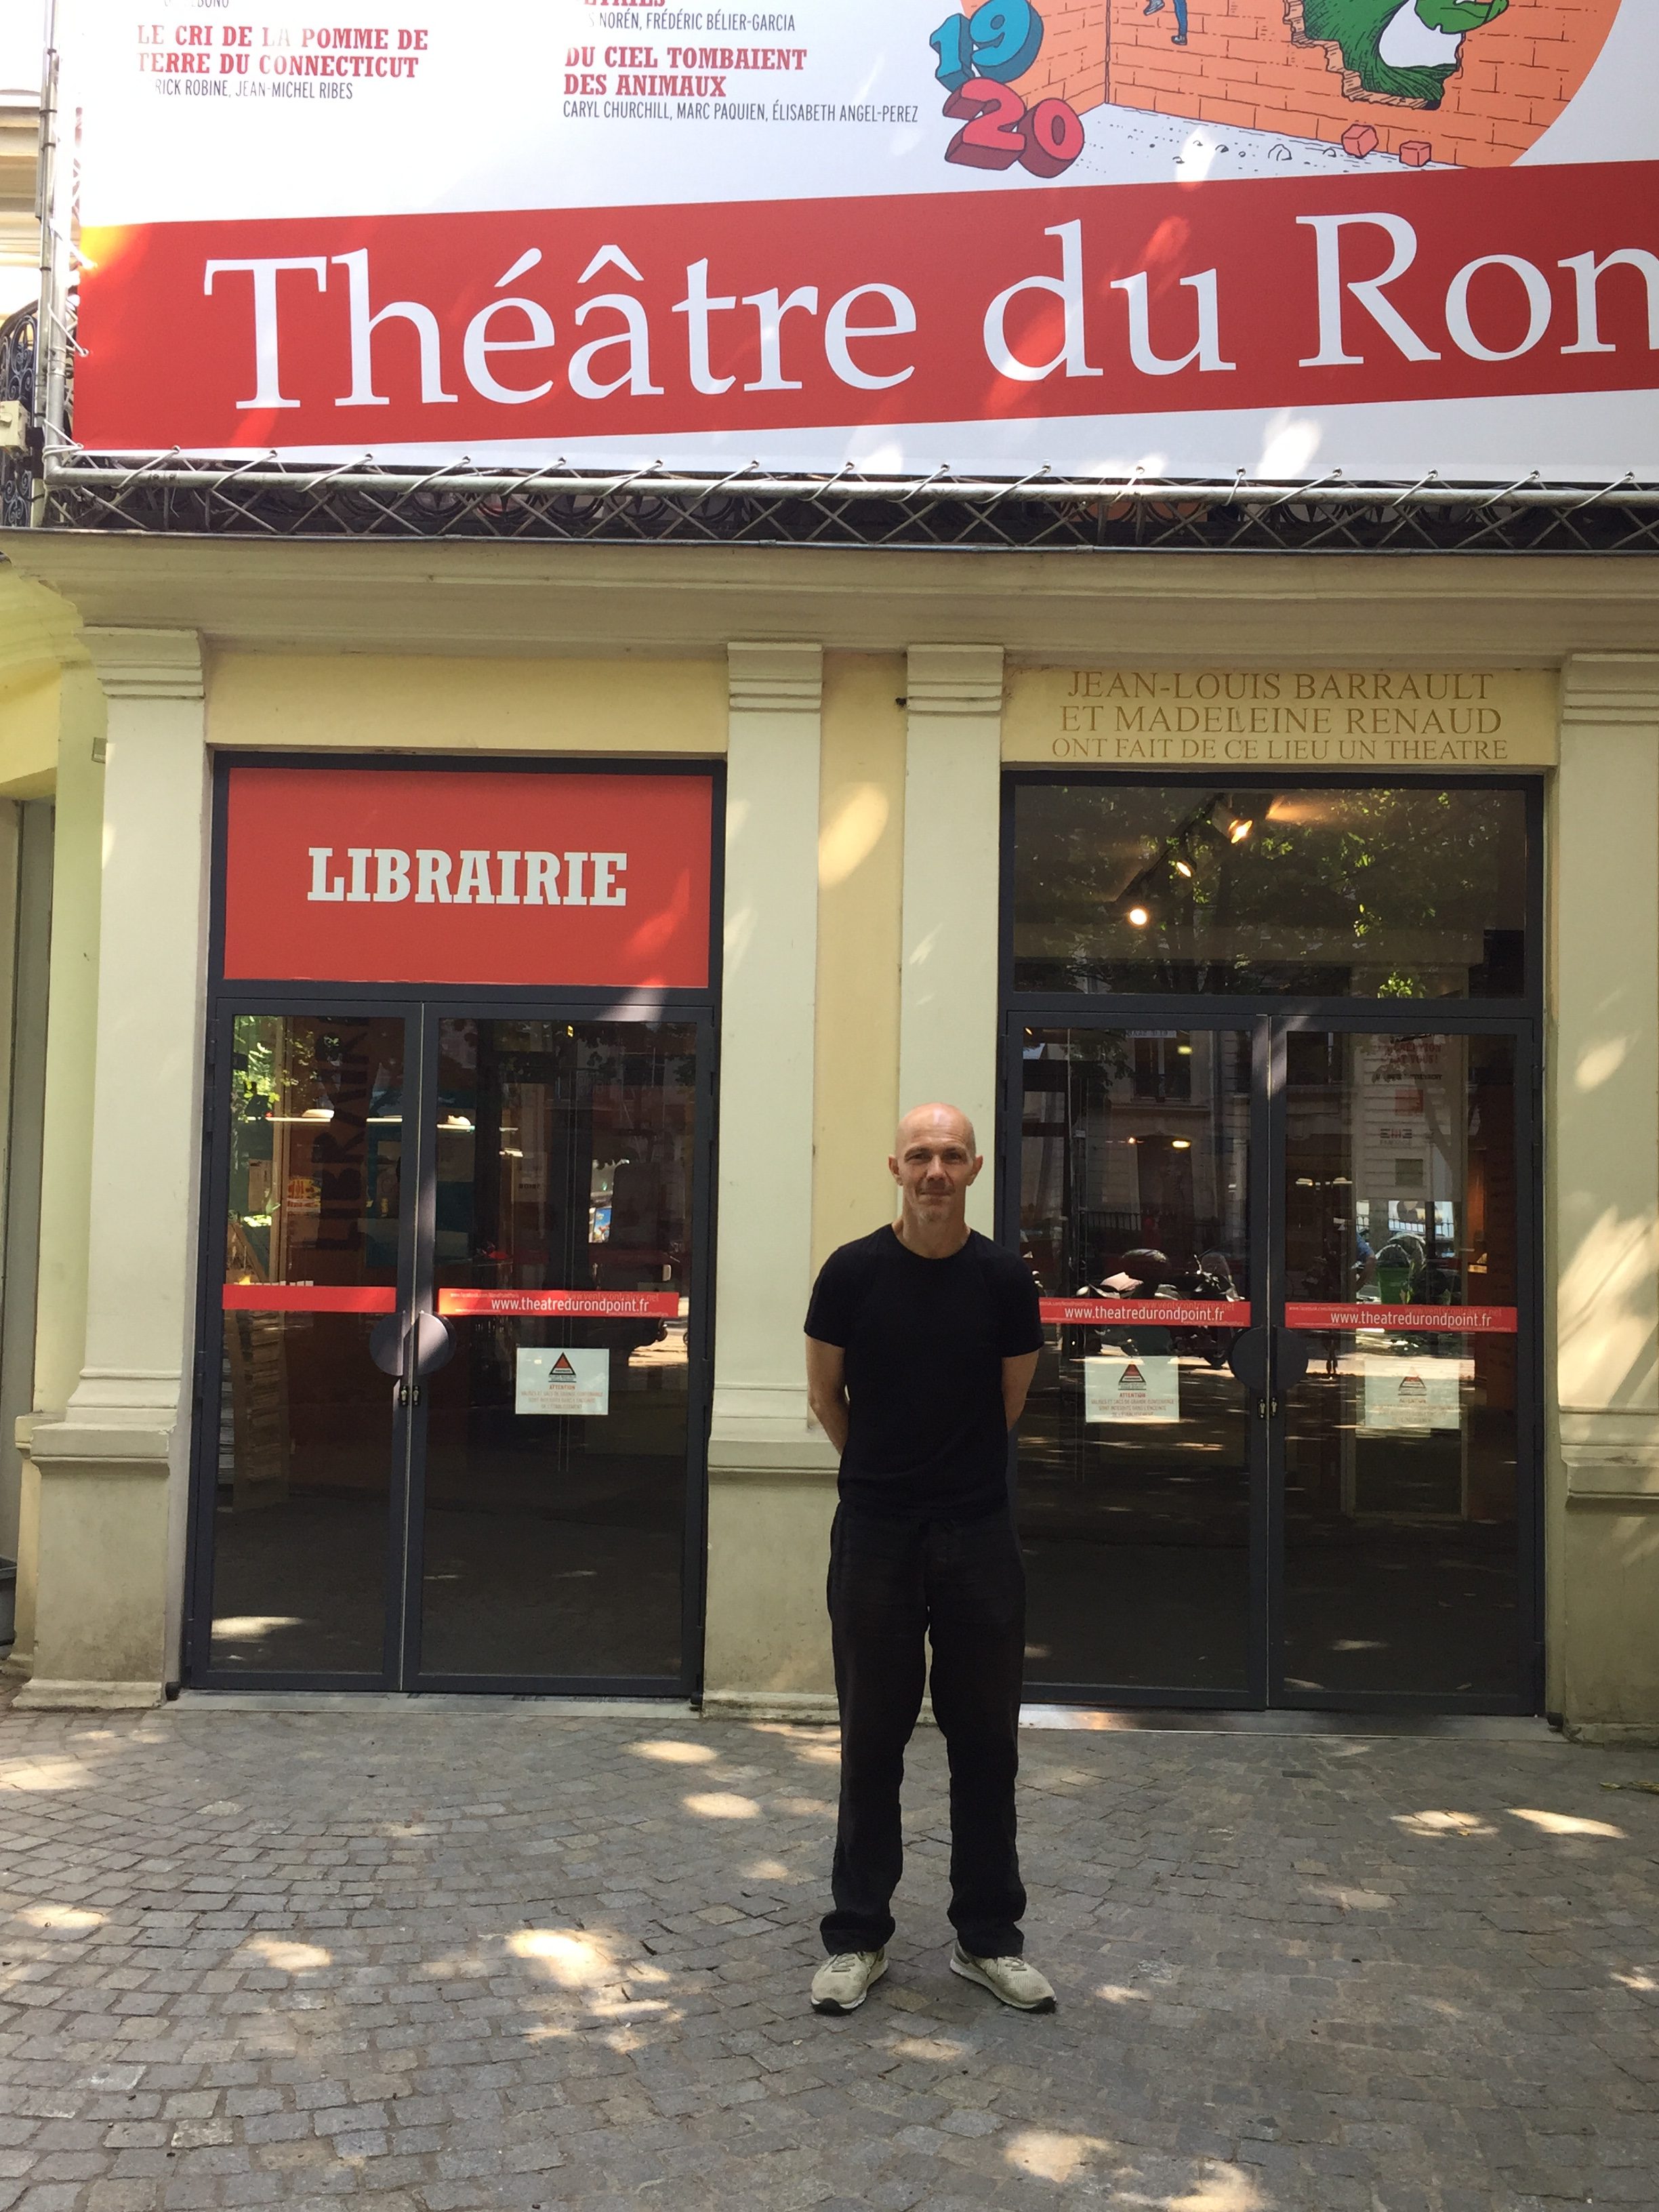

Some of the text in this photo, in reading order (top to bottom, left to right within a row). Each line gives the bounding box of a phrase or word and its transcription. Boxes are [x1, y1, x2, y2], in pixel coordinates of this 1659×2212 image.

[600, 8, 642, 30] NORÉN,
[647, 8, 703, 30] FRÉDÉRIC
[707, 9, 796, 33] BÉLIER-GARCIA
[137, 24, 428, 51] LE CRI DE LA POMME DE
[929, 0, 1044, 93] 19
[136, 52, 419, 78] TERRE DU CONNECTICUT
[565, 46, 808, 70] DU CIEL TOMBAIENT
[185, 79, 232, 98] ROBINE,
[235, 80, 315, 99] JEAN-MICHEL
[319, 81, 353, 100] RIBES
[564, 74, 727, 98] DES ANIMAUX
[563, 99, 918, 123] CARYL CHURCHILL, MARC PAQUIEN, ÉLISABETH ANGEL-PEREZ
[943, 78, 1086, 178] 20
[203, 245, 918, 409] Théâtre
[983, 219, 1236, 382] du
[1067, 671, 1494, 701] JEAN-LOUIS BARRAULT
[1060, 705, 1502, 735] ET MADELEINE RENAUD
[1052, 737, 1508, 760] ONT FAIT DE CE LIEU UN THEATRE
[307, 847, 628, 907] LIBRAIRIE
[491, 1296, 650, 1314] www.theatredurondpoint.fr
[1065, 1305, 1225, 1323] www.theatredurondpoint.fr
[1330, 1311, 1492, 1328] www.theatredurondpoint.fr
